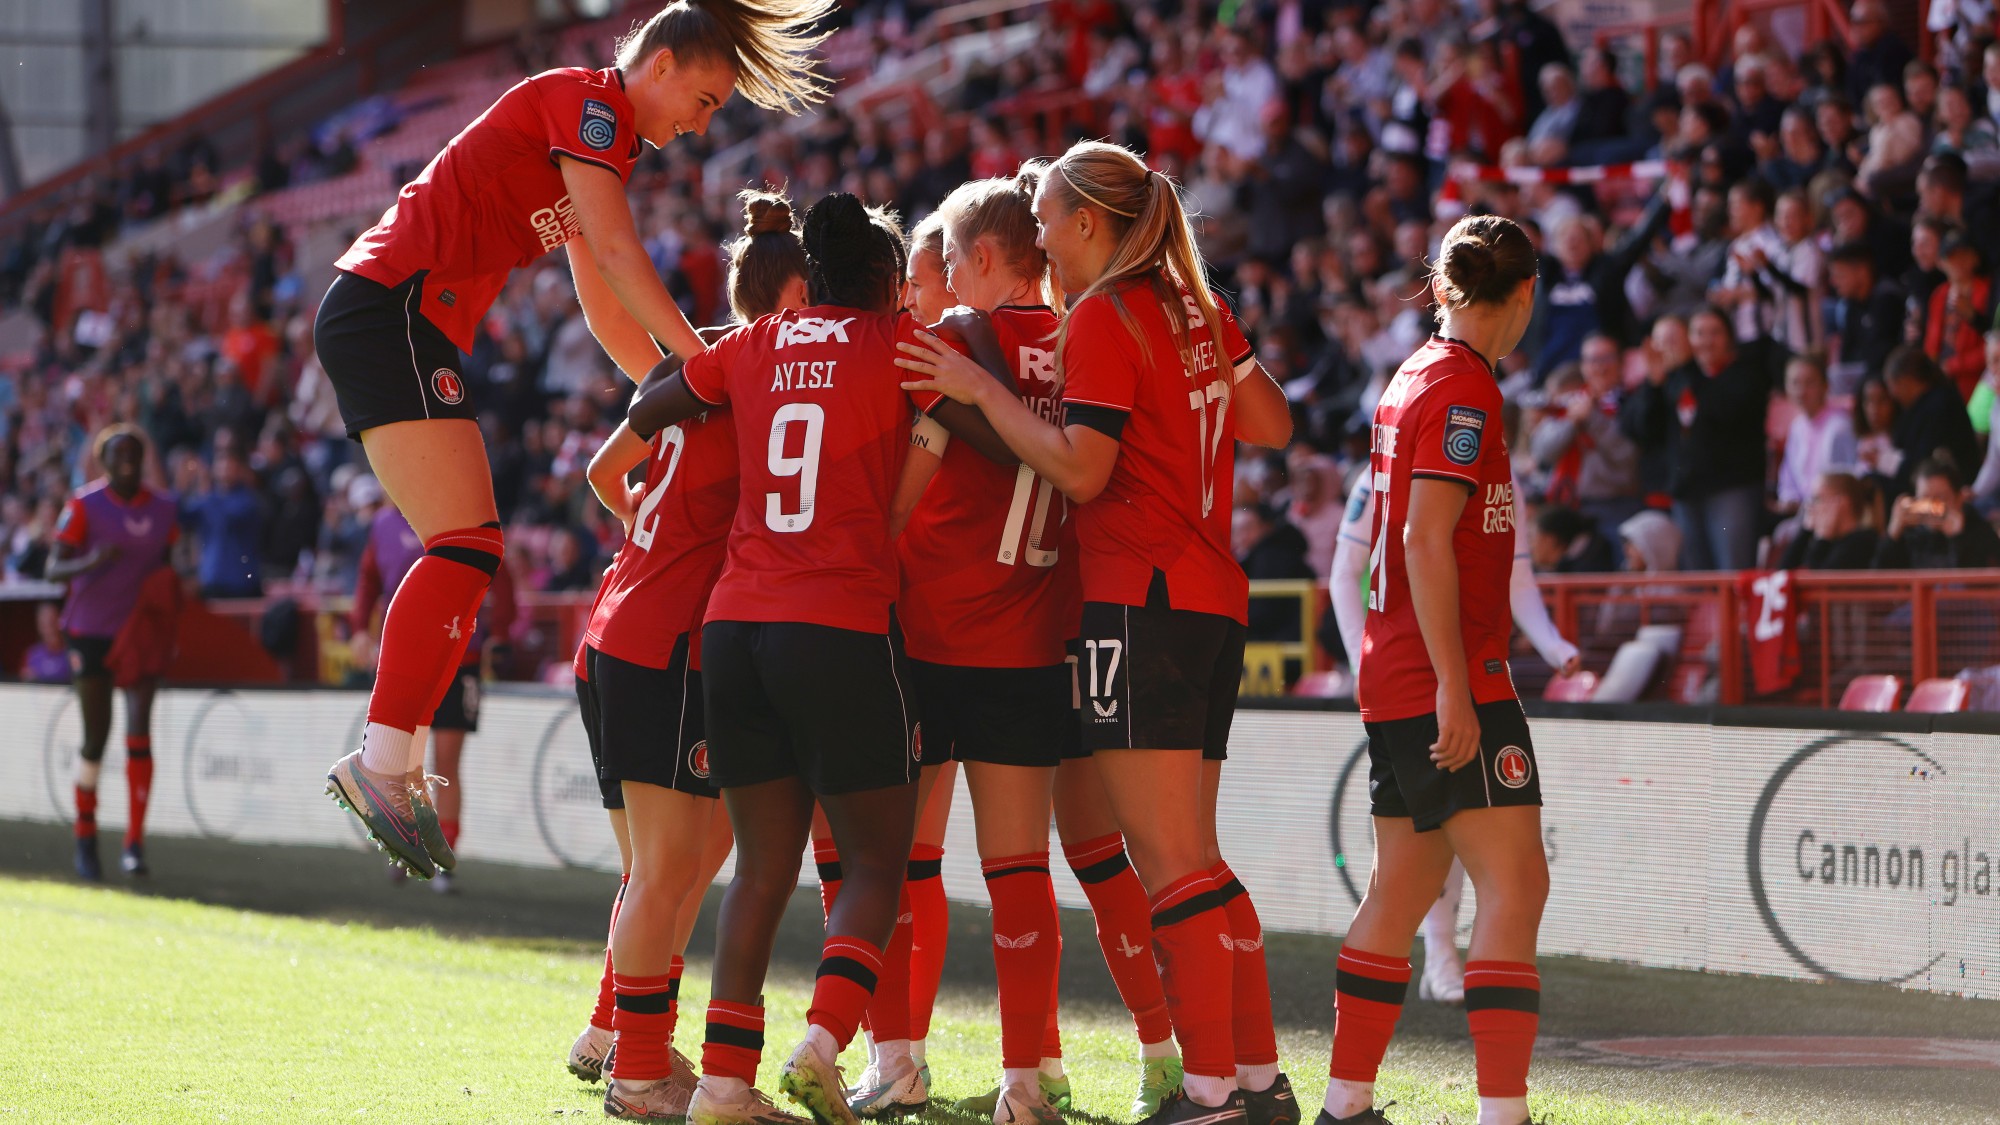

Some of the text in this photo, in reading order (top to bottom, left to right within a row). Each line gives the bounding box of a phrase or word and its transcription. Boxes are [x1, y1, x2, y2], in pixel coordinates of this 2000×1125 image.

[774, 317, 857, 350] RSK
[770, 361, 837, 392] AYISI
[1189, 380, 1230, 519] 17
[1451, 414, 1483, 426] WOMEN'S
[632, 415, 685, 553] 2
[766, 403, 825, 533] 9
[1085, 639, 1122, 697] 17
[1797, 828, 2000, 907] Cannon gla
